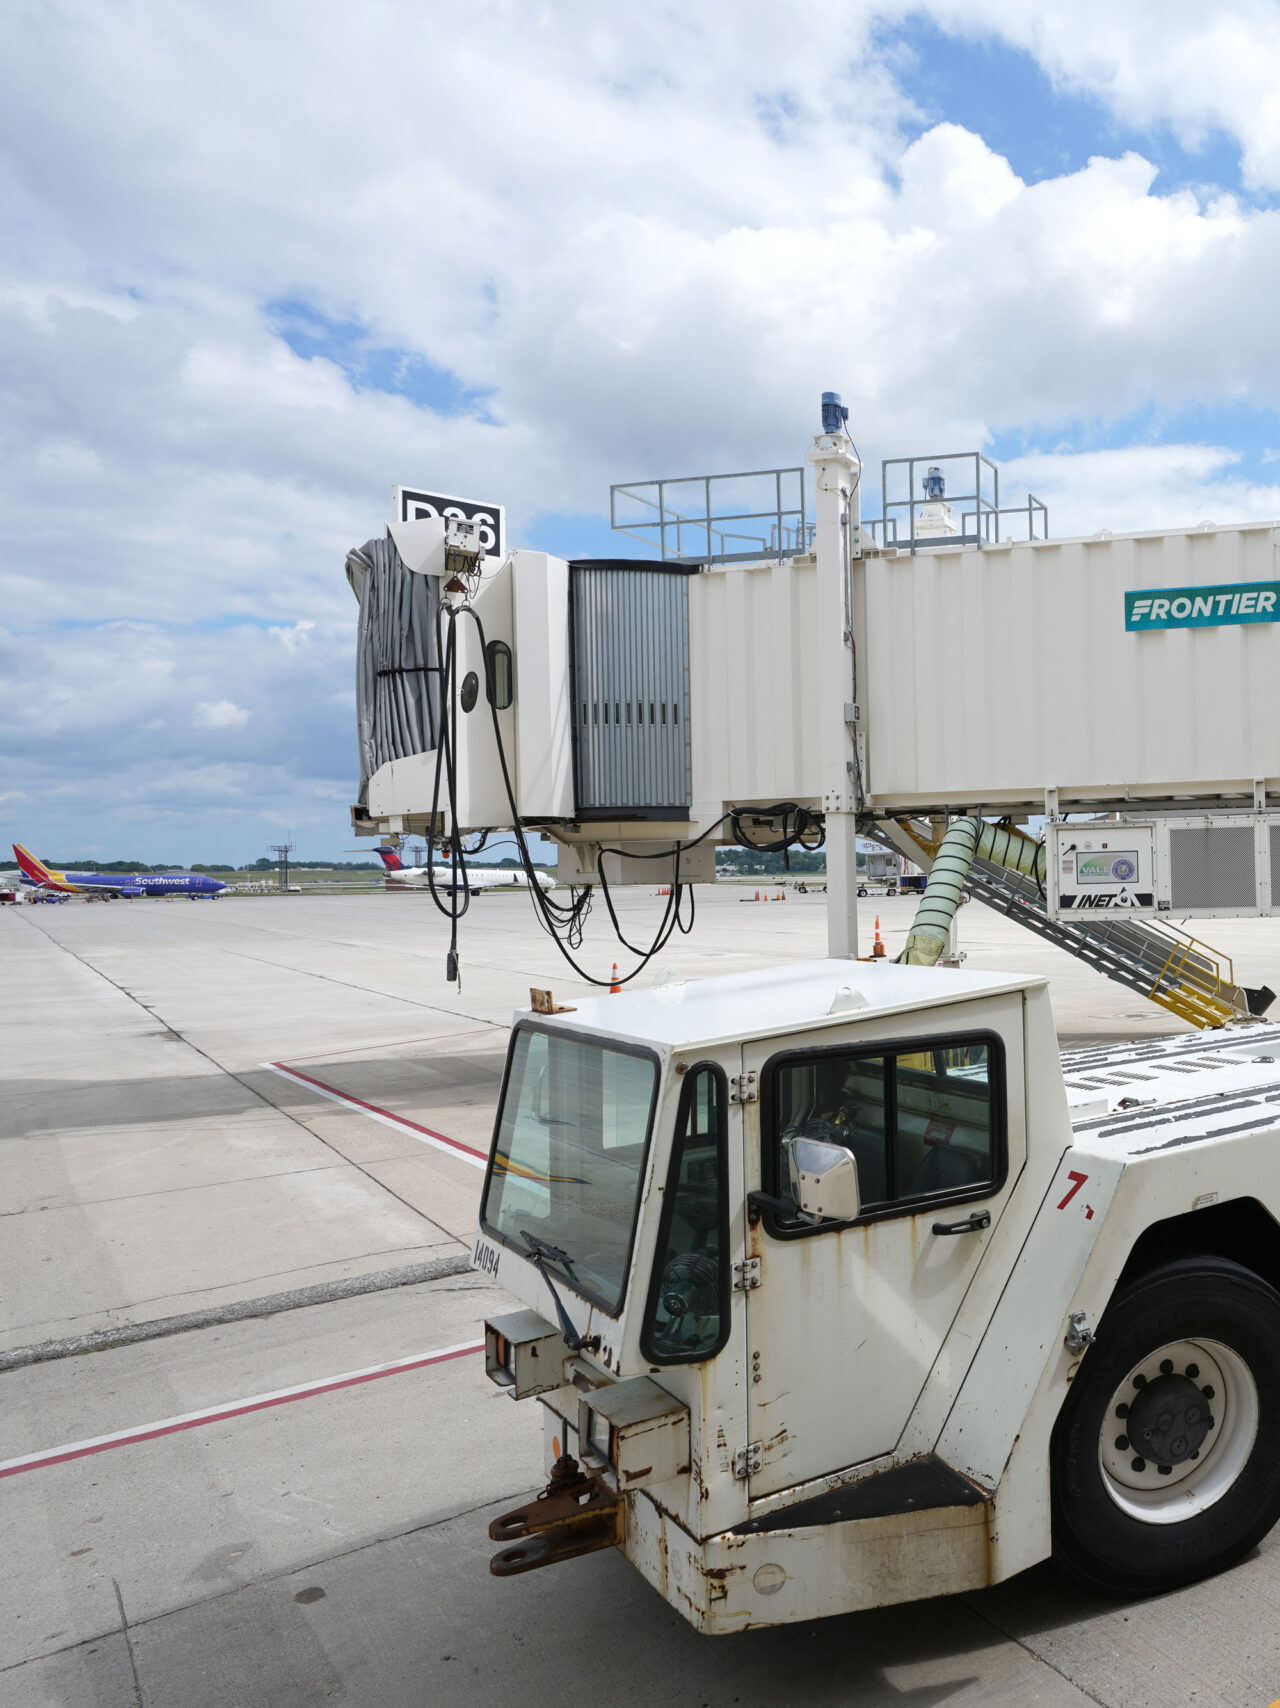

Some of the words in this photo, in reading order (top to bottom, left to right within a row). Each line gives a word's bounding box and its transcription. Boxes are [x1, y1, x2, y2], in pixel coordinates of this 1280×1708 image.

[1130, 591, 1277, 622] FRONTIER
[135, 877, 190, 886] Southwest
[473, 1239, 500, 1280] 14094
